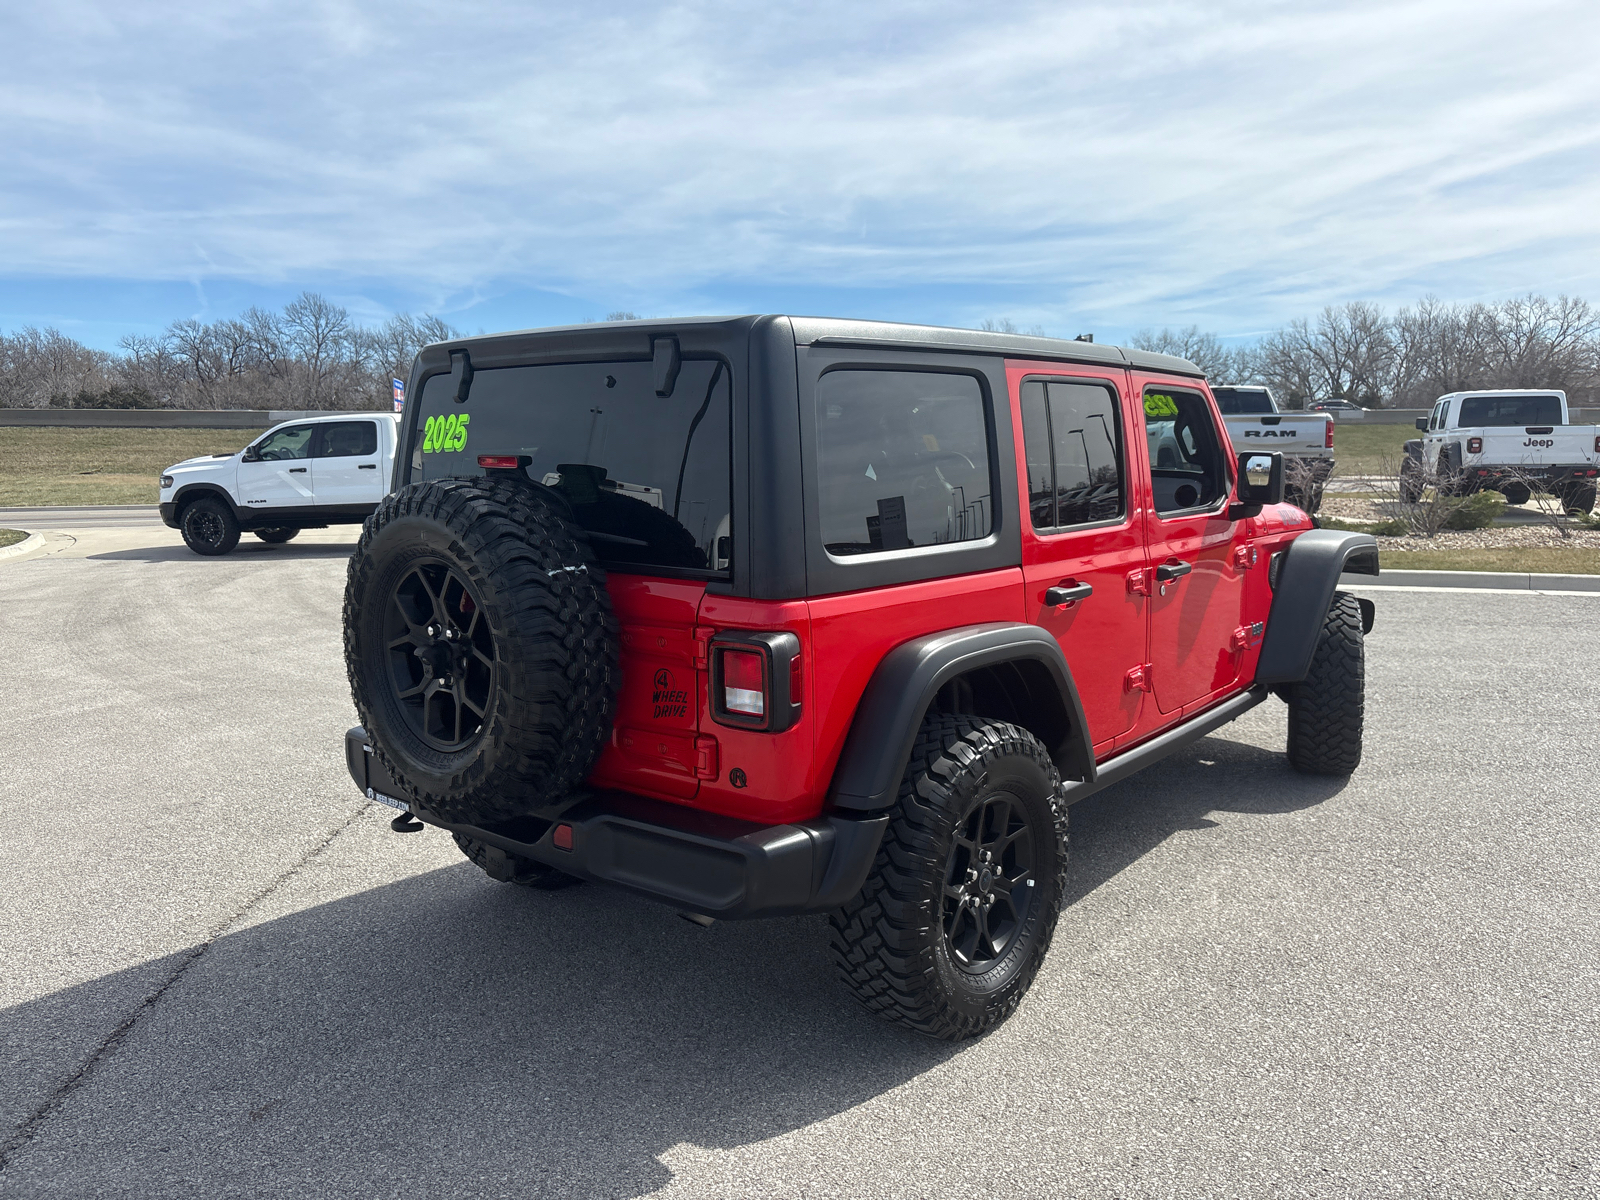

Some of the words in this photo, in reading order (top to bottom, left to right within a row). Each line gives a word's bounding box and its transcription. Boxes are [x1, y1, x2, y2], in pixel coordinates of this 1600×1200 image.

[422, 413, 470, 453] 2025
[1523, 437, 1554, 448] Jeep
[652, 690, 688, 704] WHEEL
[653, 704, 688, 719] DRIVE
